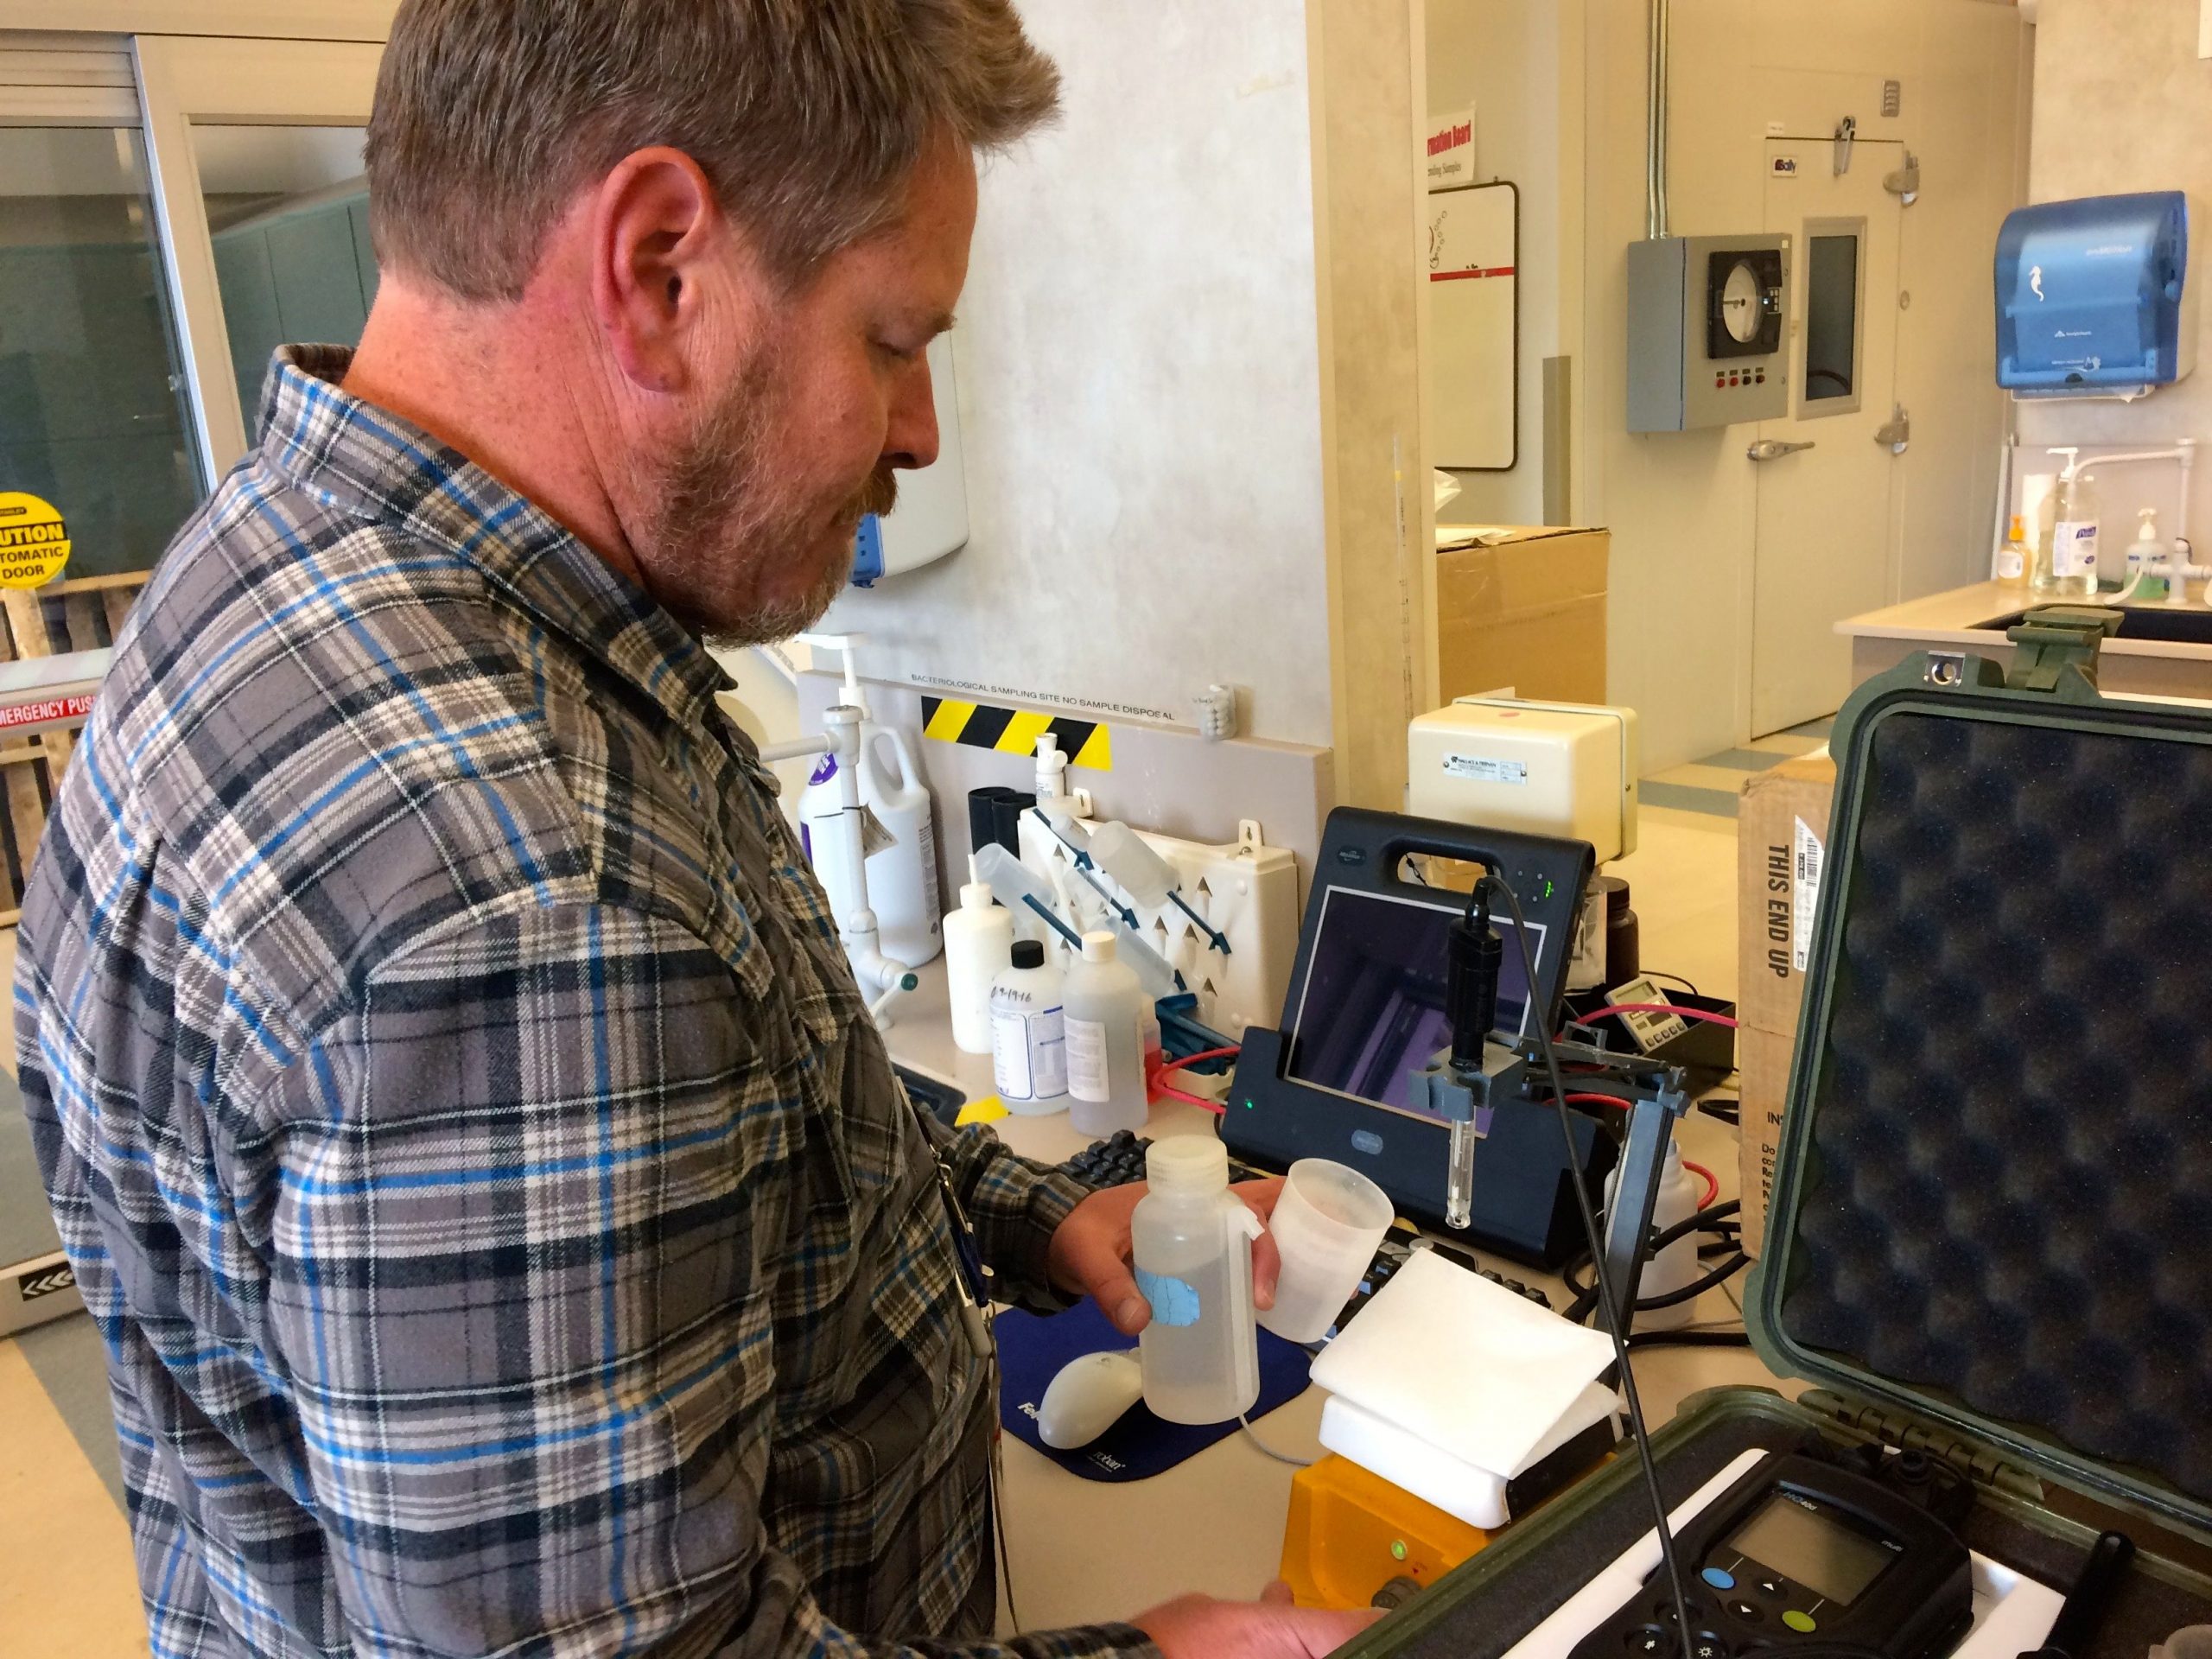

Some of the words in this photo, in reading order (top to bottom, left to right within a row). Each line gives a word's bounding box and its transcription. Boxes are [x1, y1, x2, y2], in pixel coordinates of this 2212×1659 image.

[3, 564, 45, 580] DOOR
[67, 695, 97, 715] PUS
[911, 673, 988, 692] BACTERIOLOGICAL
[990, 685, 1038, 699] SAMPLING
[1039, 692, 1060, 702] SITE
[1062, 696, 1077, 705] NO
[1079, 699, 1120, 712] SAMPLE
[1122, 705, 1175, 721] DISPOSAL
[1768, 844, 1790, 893] THIS
[1768, 899, 1789, 943] END
[1768, 948, 1789, 979] UP
[1762, 1142, 1776, 1155] Do
